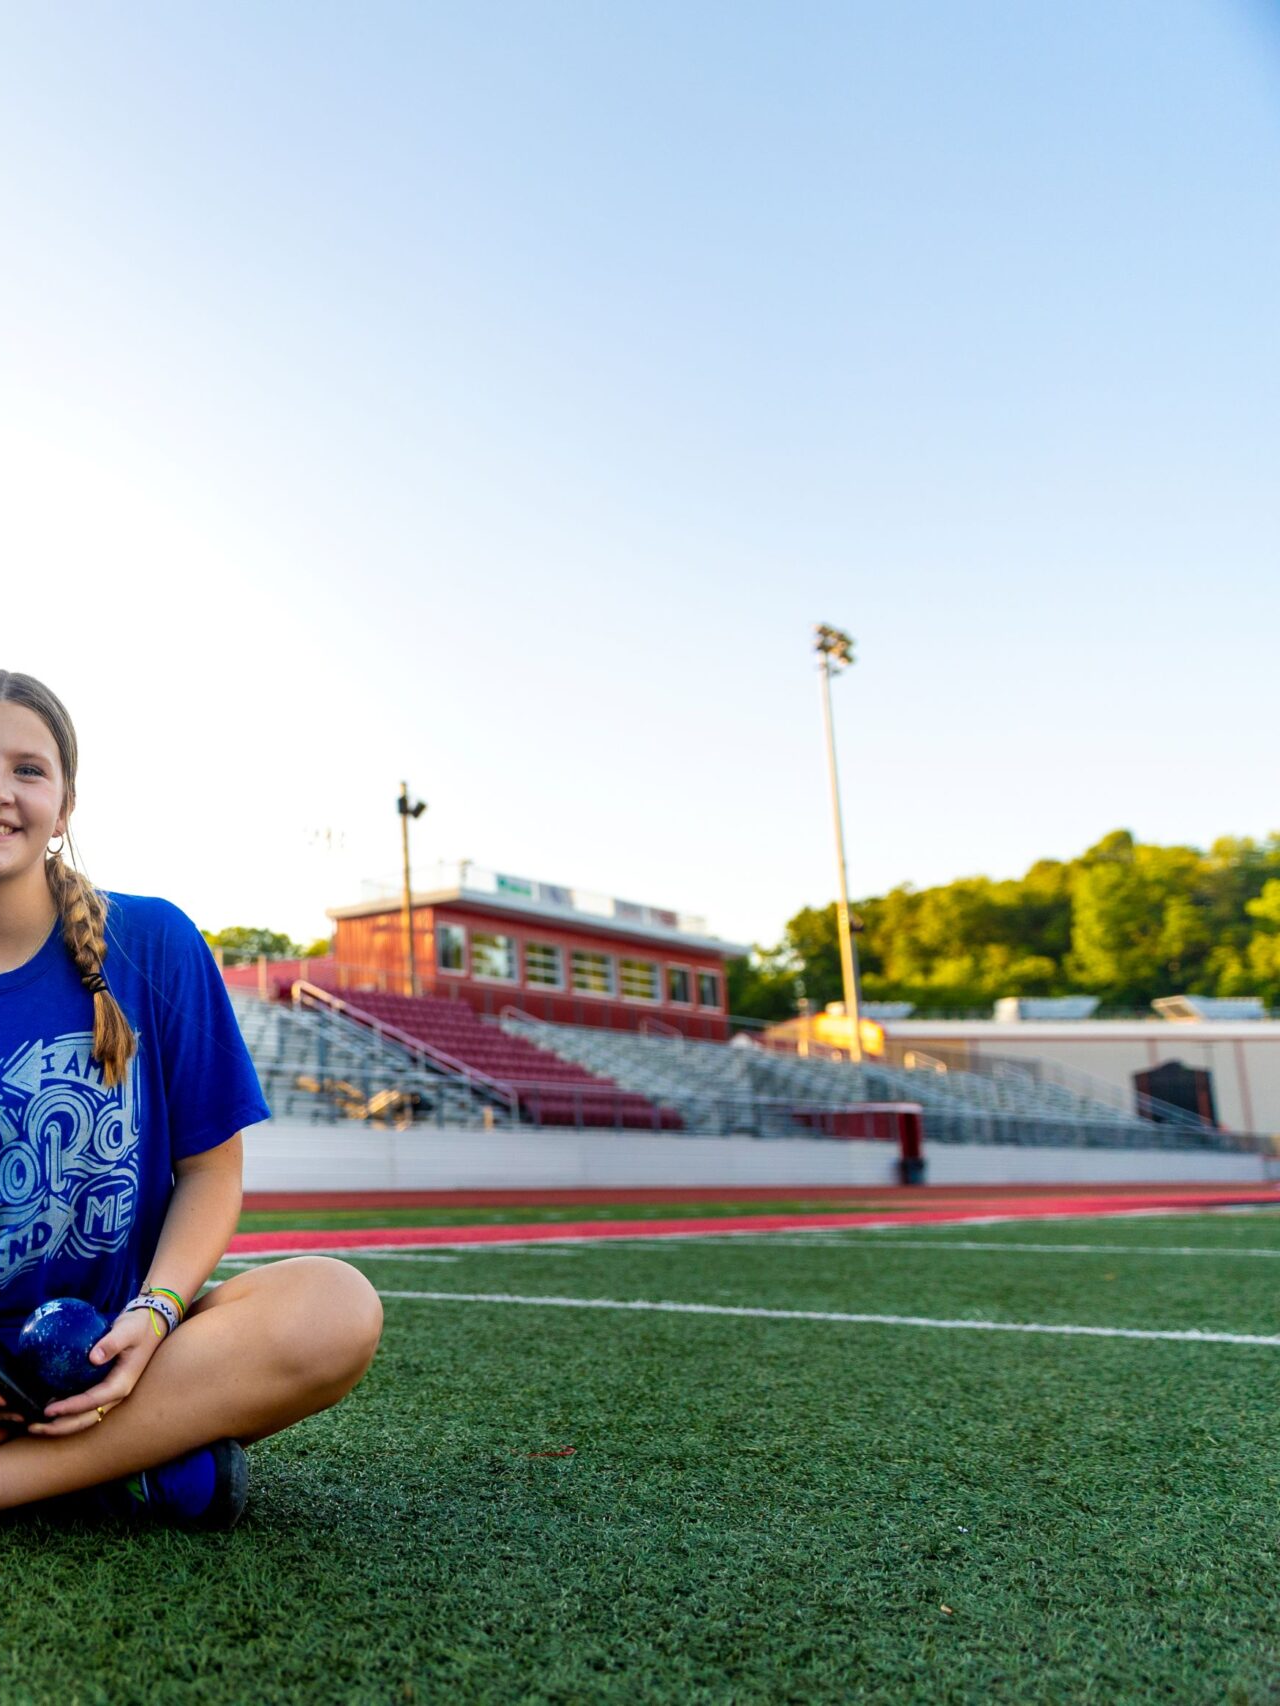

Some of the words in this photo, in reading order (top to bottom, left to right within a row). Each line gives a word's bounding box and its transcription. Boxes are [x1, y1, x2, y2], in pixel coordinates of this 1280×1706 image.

[41, 1052, 55, 1074] I
[62, 1049, 106, 1085] AM
[84, 1186, 135, 1235] ME
